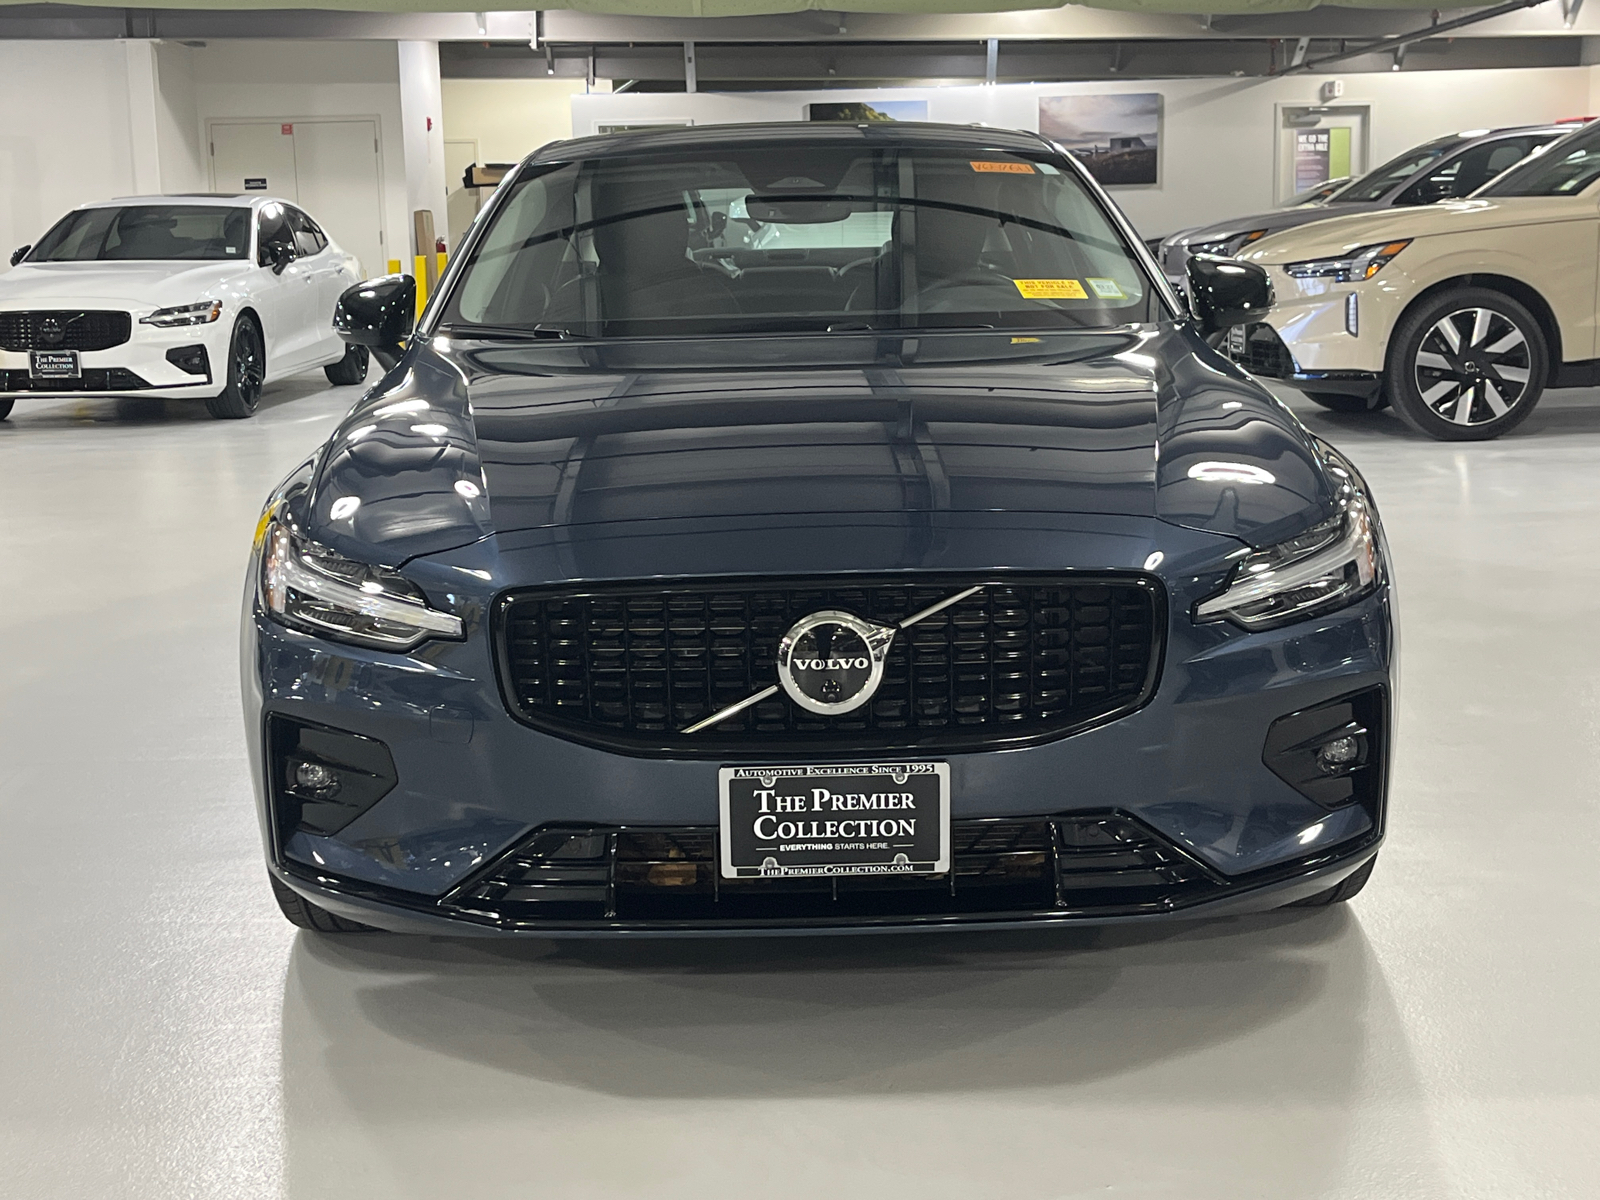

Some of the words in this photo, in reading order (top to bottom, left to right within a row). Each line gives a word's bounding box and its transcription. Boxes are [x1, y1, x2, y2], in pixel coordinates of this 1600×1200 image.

[1308, 134, 1316, 143] GO
[1317, 134, 1328, 142] THE
[793, 657, 869, 671] VOLVO
[736, 768, 803, 778] AUTOMOTIVE
[806, 766, 869, 776] EXCELLENCE
[871, 765, 901, 775] SINCE
[905, 764, 933, 774] 1995
[753, 789, 807, 813] THE
[810, 788, 916, 812] PREMIER
[753, 815, 917, 840] COLLECTION
[779, 843, 833, 852] EVERYTHING
[834, 842, 865, 850] STARTS
[757, 865, 914, 877] THEPREMIERCOLLECTION.COM
